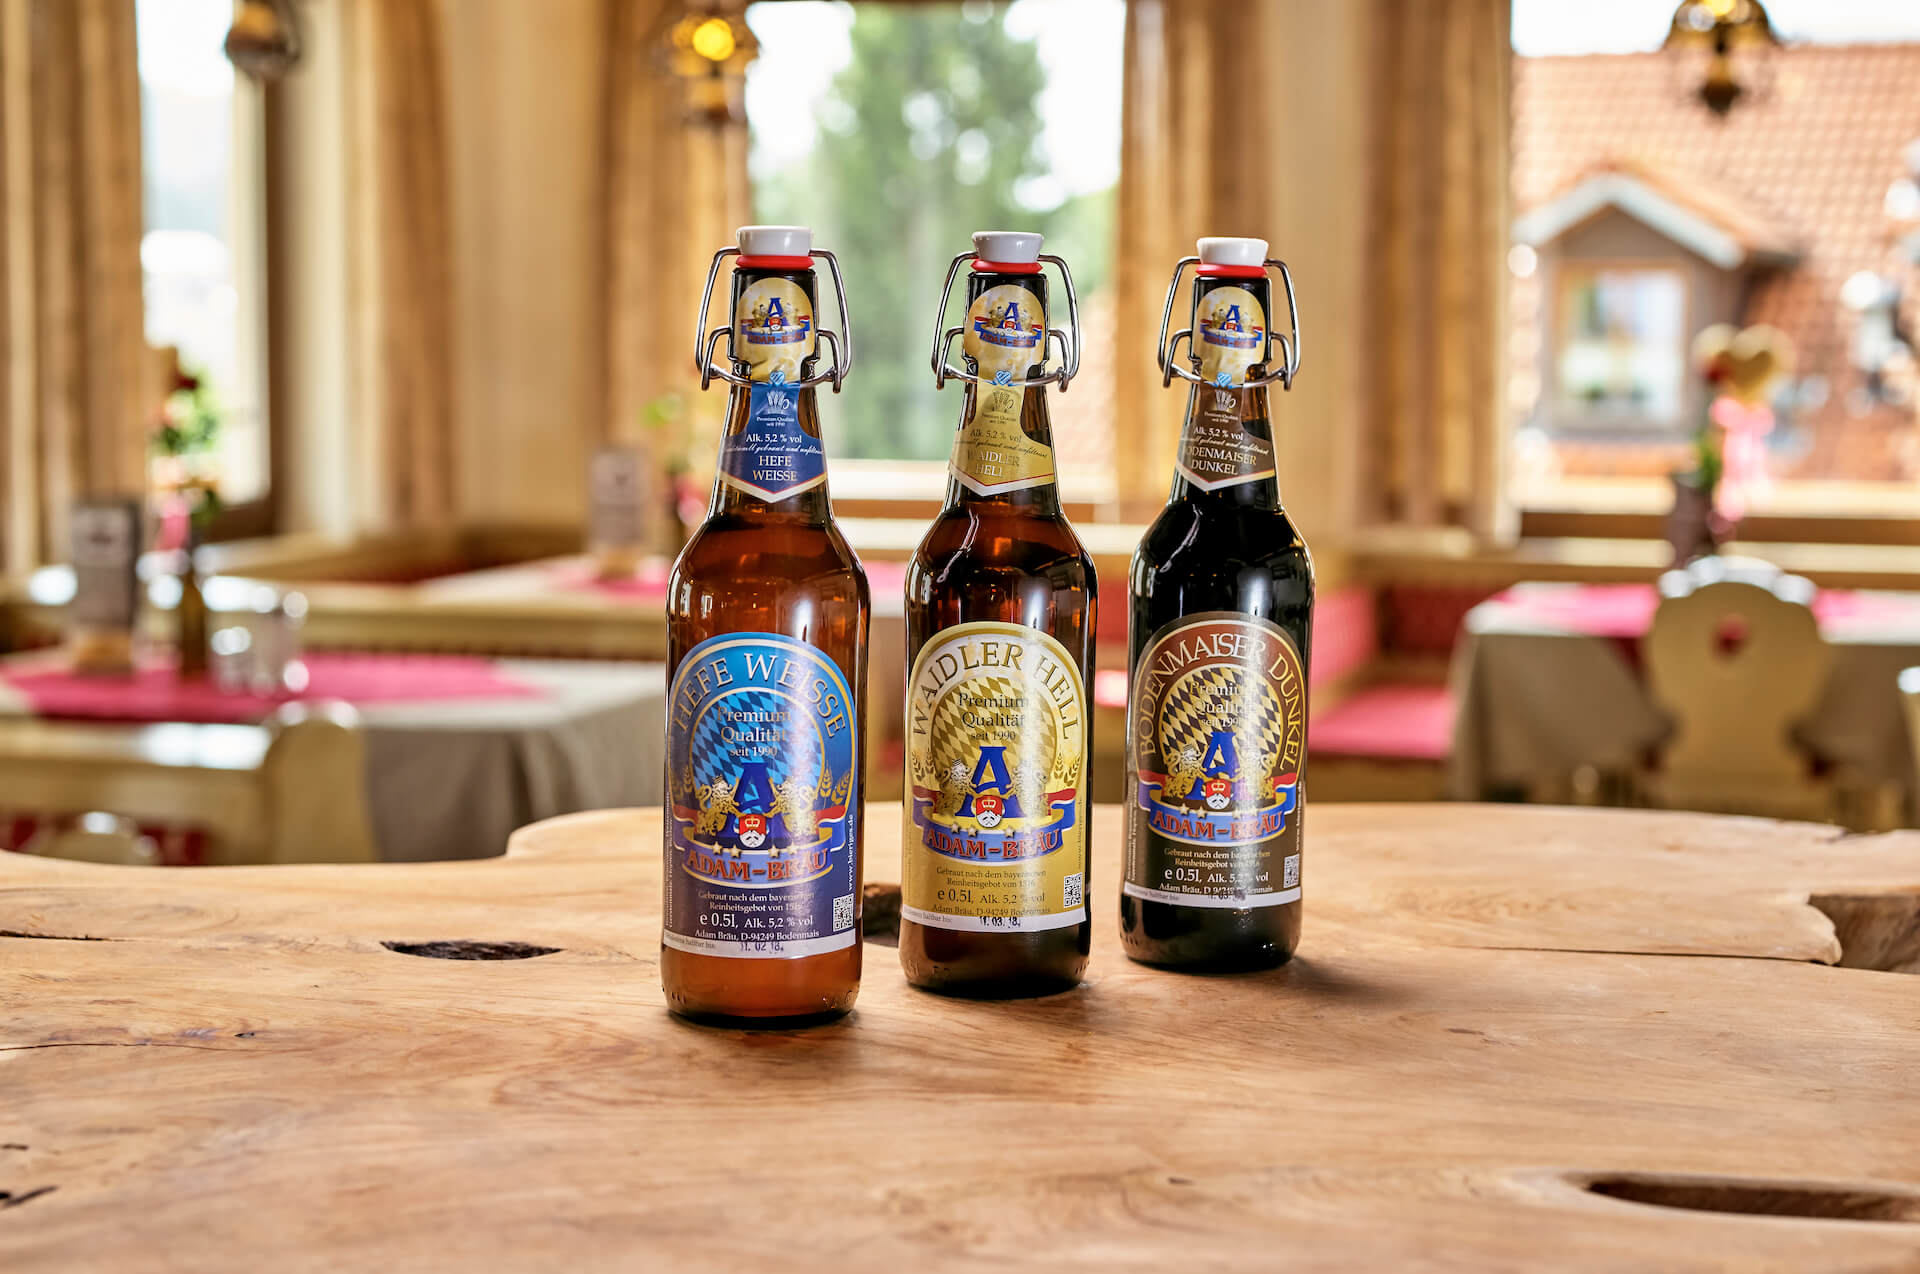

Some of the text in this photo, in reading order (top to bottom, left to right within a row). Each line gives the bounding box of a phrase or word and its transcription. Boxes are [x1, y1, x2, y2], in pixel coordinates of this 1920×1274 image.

[746, 433, 802, 443] Alk. 5,2 % vol
[1208, 428, 1220, 437] 5,2
[1231, 432, 1244, 440] vol
[759, 455, 793, 467] HEFE
[1183, 445, 1257, 466] ODENMAISER
[753, 469, 799, 481] WEISSE
[1191, 459, 1239, 476] DUNKEL
[673, 652, 846, 739] HEFE WEISSE
[913, 641, 1079, 740] WAIDLER HELL
[1190, 681, 1246, 696] Premiu
[958, 692, 1029, 708] Premium
[1139, 632, 1301, 770] BODENMAISER DUNKEL
[1194, 700, 1246, 715] Qualit
[717, 706, 792, 722] Premium
[962, 711, 1025, 728] Qualität
[720, 726, 787, 745] Qualität
[971, 730, 1016, 740] seit 1990
[730, 746, 778, 757] seit 1990
[1152, 811, 1283, 840] ADAM-BRÄU
[925, 828, 1060, 859] ADAM-BRÄU
[1164, 847, 1193, 857] Gebraut
[1194, 850, 1212, 859] nach
[1213, 850, 1230, 859] dem
[1175, 858, 1228, 870] Reinheitsgebot
[936, 867, 964, 876] Gebraut
[965, 870, 983, 879] nach
[984, 870, 1002, 879] dem
[1164, 868, 1173, 880] e
[1207, 873, 1228, 883] Alk.
[1255, 871, 1269, 882] vol
[947, 878, 1000, 889] Reinheitsgebot
[1159, 882, 1180, 892] Adam
[1236, 884, 1273, 895] denmais
[698, 890, 727, 899] Gebraut
[728, 893, 747, 902] nach
[749, 893, 768, 902] dem
[937, 890, 945, 900] e
[979, 894, 1001, 904] Alk.
[1002, 894, 1017, 905] 5,2
[1032, 892, 1045, 902] vol
[709, 902, 766, 913] Reinheitsgebot
[933, 904, 953, 913] Adam
[700, 913, 708, 925] e
[744, 918, 766, 928] Alk.
[768, 918, 784, 930] 5,2
[786, 917, 796, 926] %
[798, 915, 813, 926] vol
[695, 929, 717, 939] Adam
[718, 931, 739, 941] Bräu,
[741, 932, 775, 941] D-94249
[776, 929, 820, 940] Bodenmais
